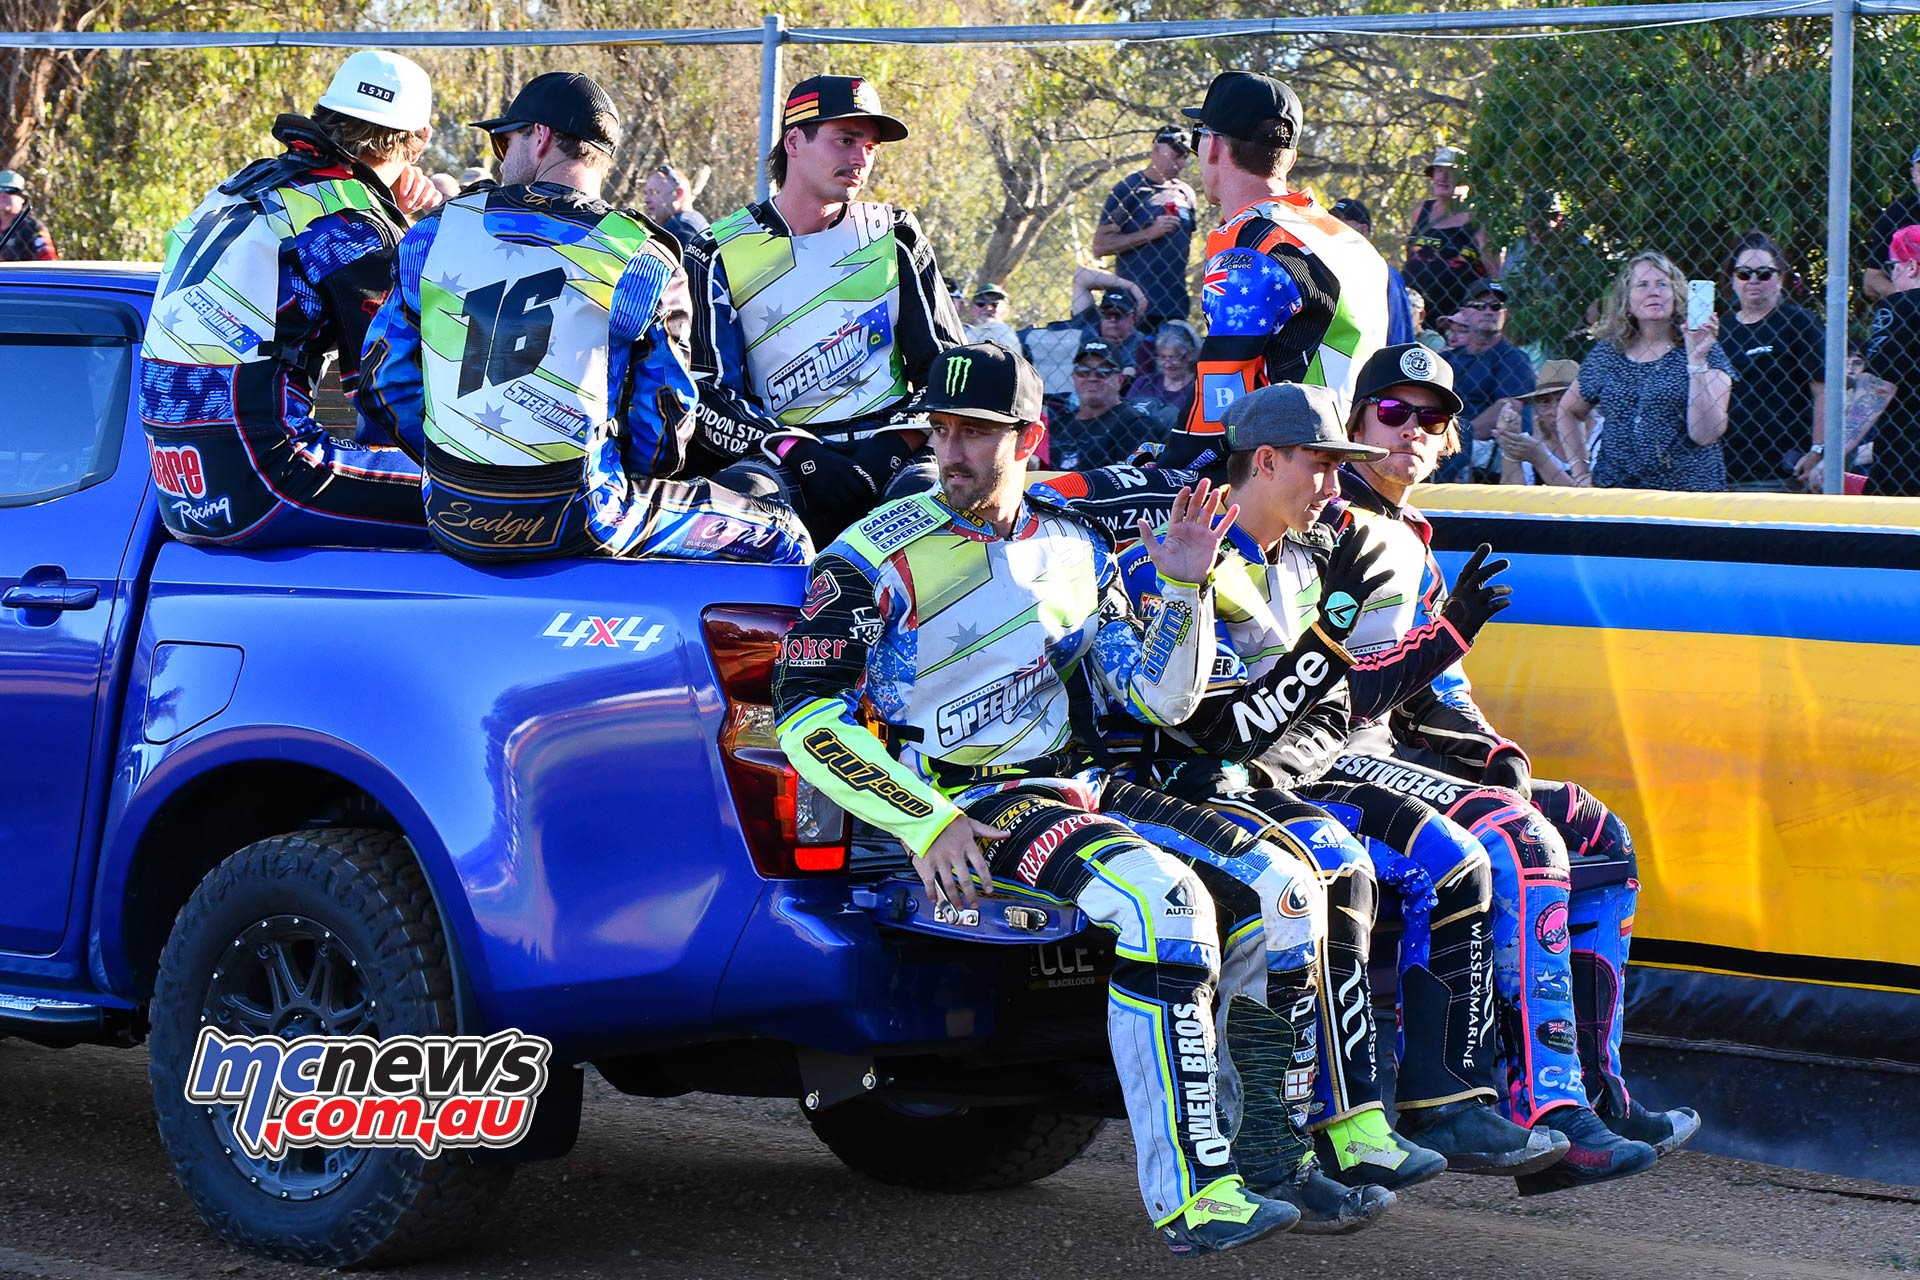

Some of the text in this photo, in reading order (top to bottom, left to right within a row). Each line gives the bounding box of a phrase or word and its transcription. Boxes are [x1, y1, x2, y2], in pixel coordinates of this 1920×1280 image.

[458, 266, 567, 399] 16
[768, 325, 870, 412] SPEEDWAY
[504, 381, 586, 437] SPEEDWAY
[172, 497, 232, 528] Racing
[438, 501, 545, 543] Sedgy
[863, 501, 917, 532] GARAGE
[870, 511, 921, 542] PORT
[789, 659, 826, 667] MACHINE
[949, 682, 1002, 710] AUSTRALIAN
[1232, 651, 1329, 743] Nice
[1048, 976, 1096, 988] BLACKLOCKS
[1463, 921, 1483, 1069] WESSEXMARINE
[1173, 1003, 1208, 1073] BROS
[1186, 1081, 1231, 1167] OWEN
